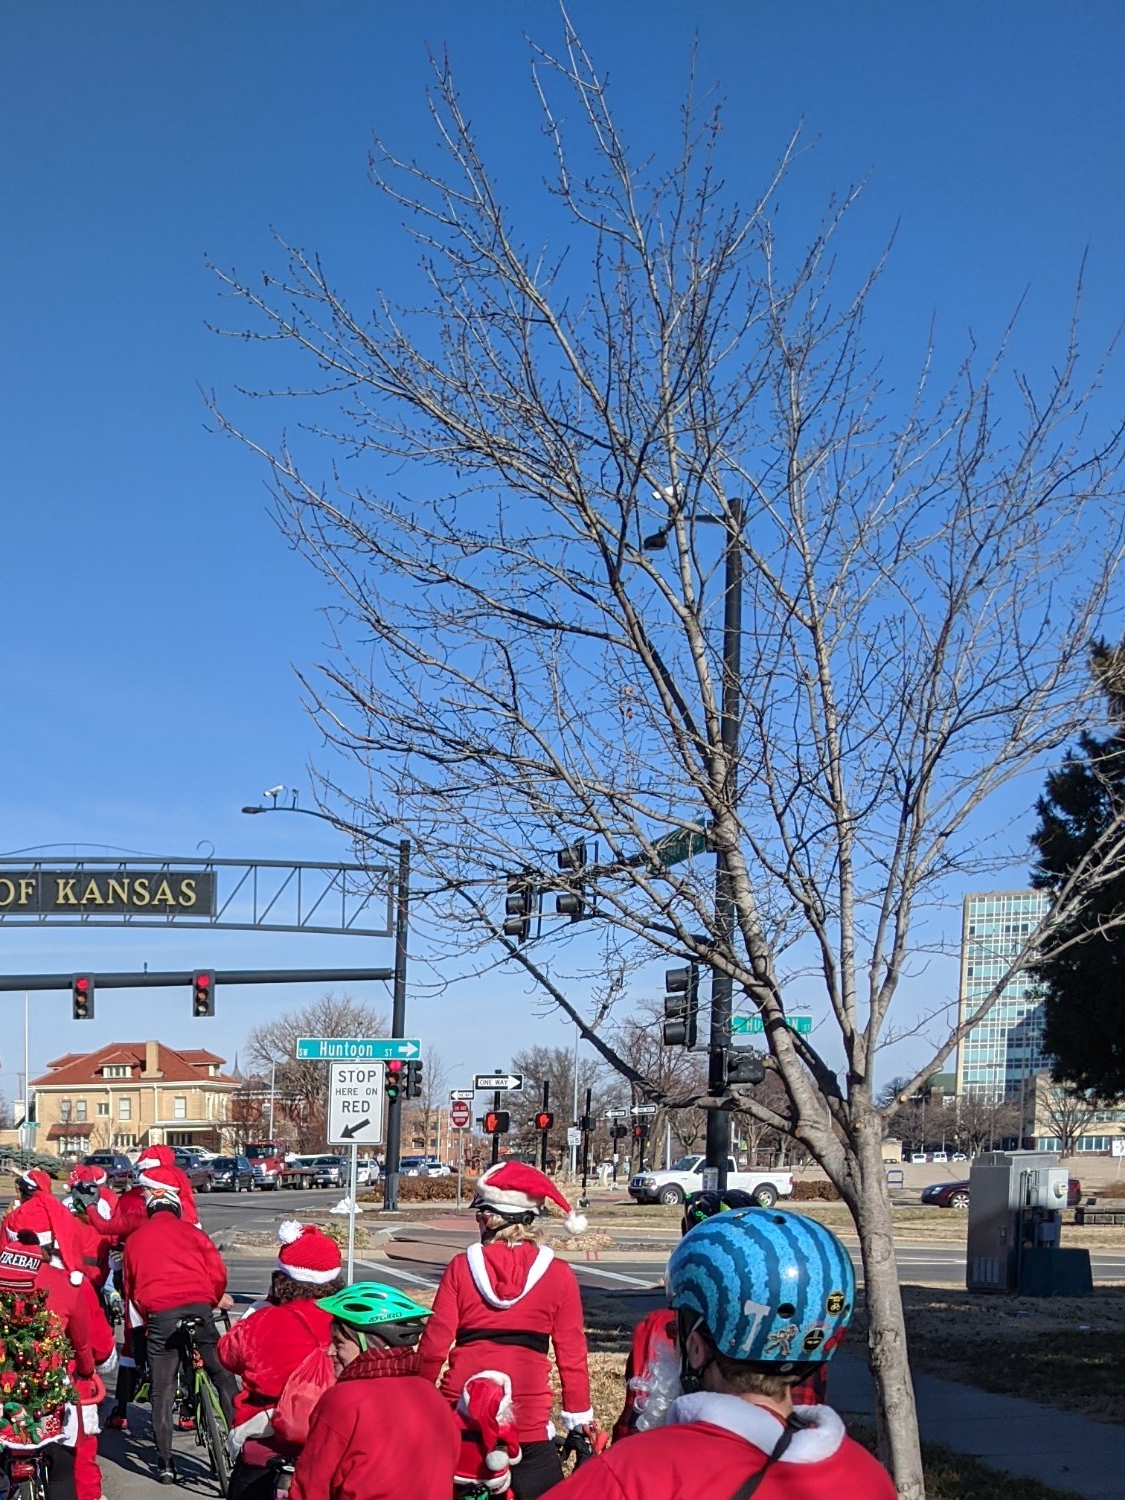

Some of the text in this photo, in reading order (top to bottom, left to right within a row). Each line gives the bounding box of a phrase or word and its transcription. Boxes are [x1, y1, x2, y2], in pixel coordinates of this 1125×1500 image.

[56, 878, 197, 907] KANSAS
[299, 1041, 393, 1057] SW Huntoon ST
[338, 1070, 377, 1083] STOP
[335, 1087, 378, 1096] HERE ON
[341, 1100, 371, 1113] RED
